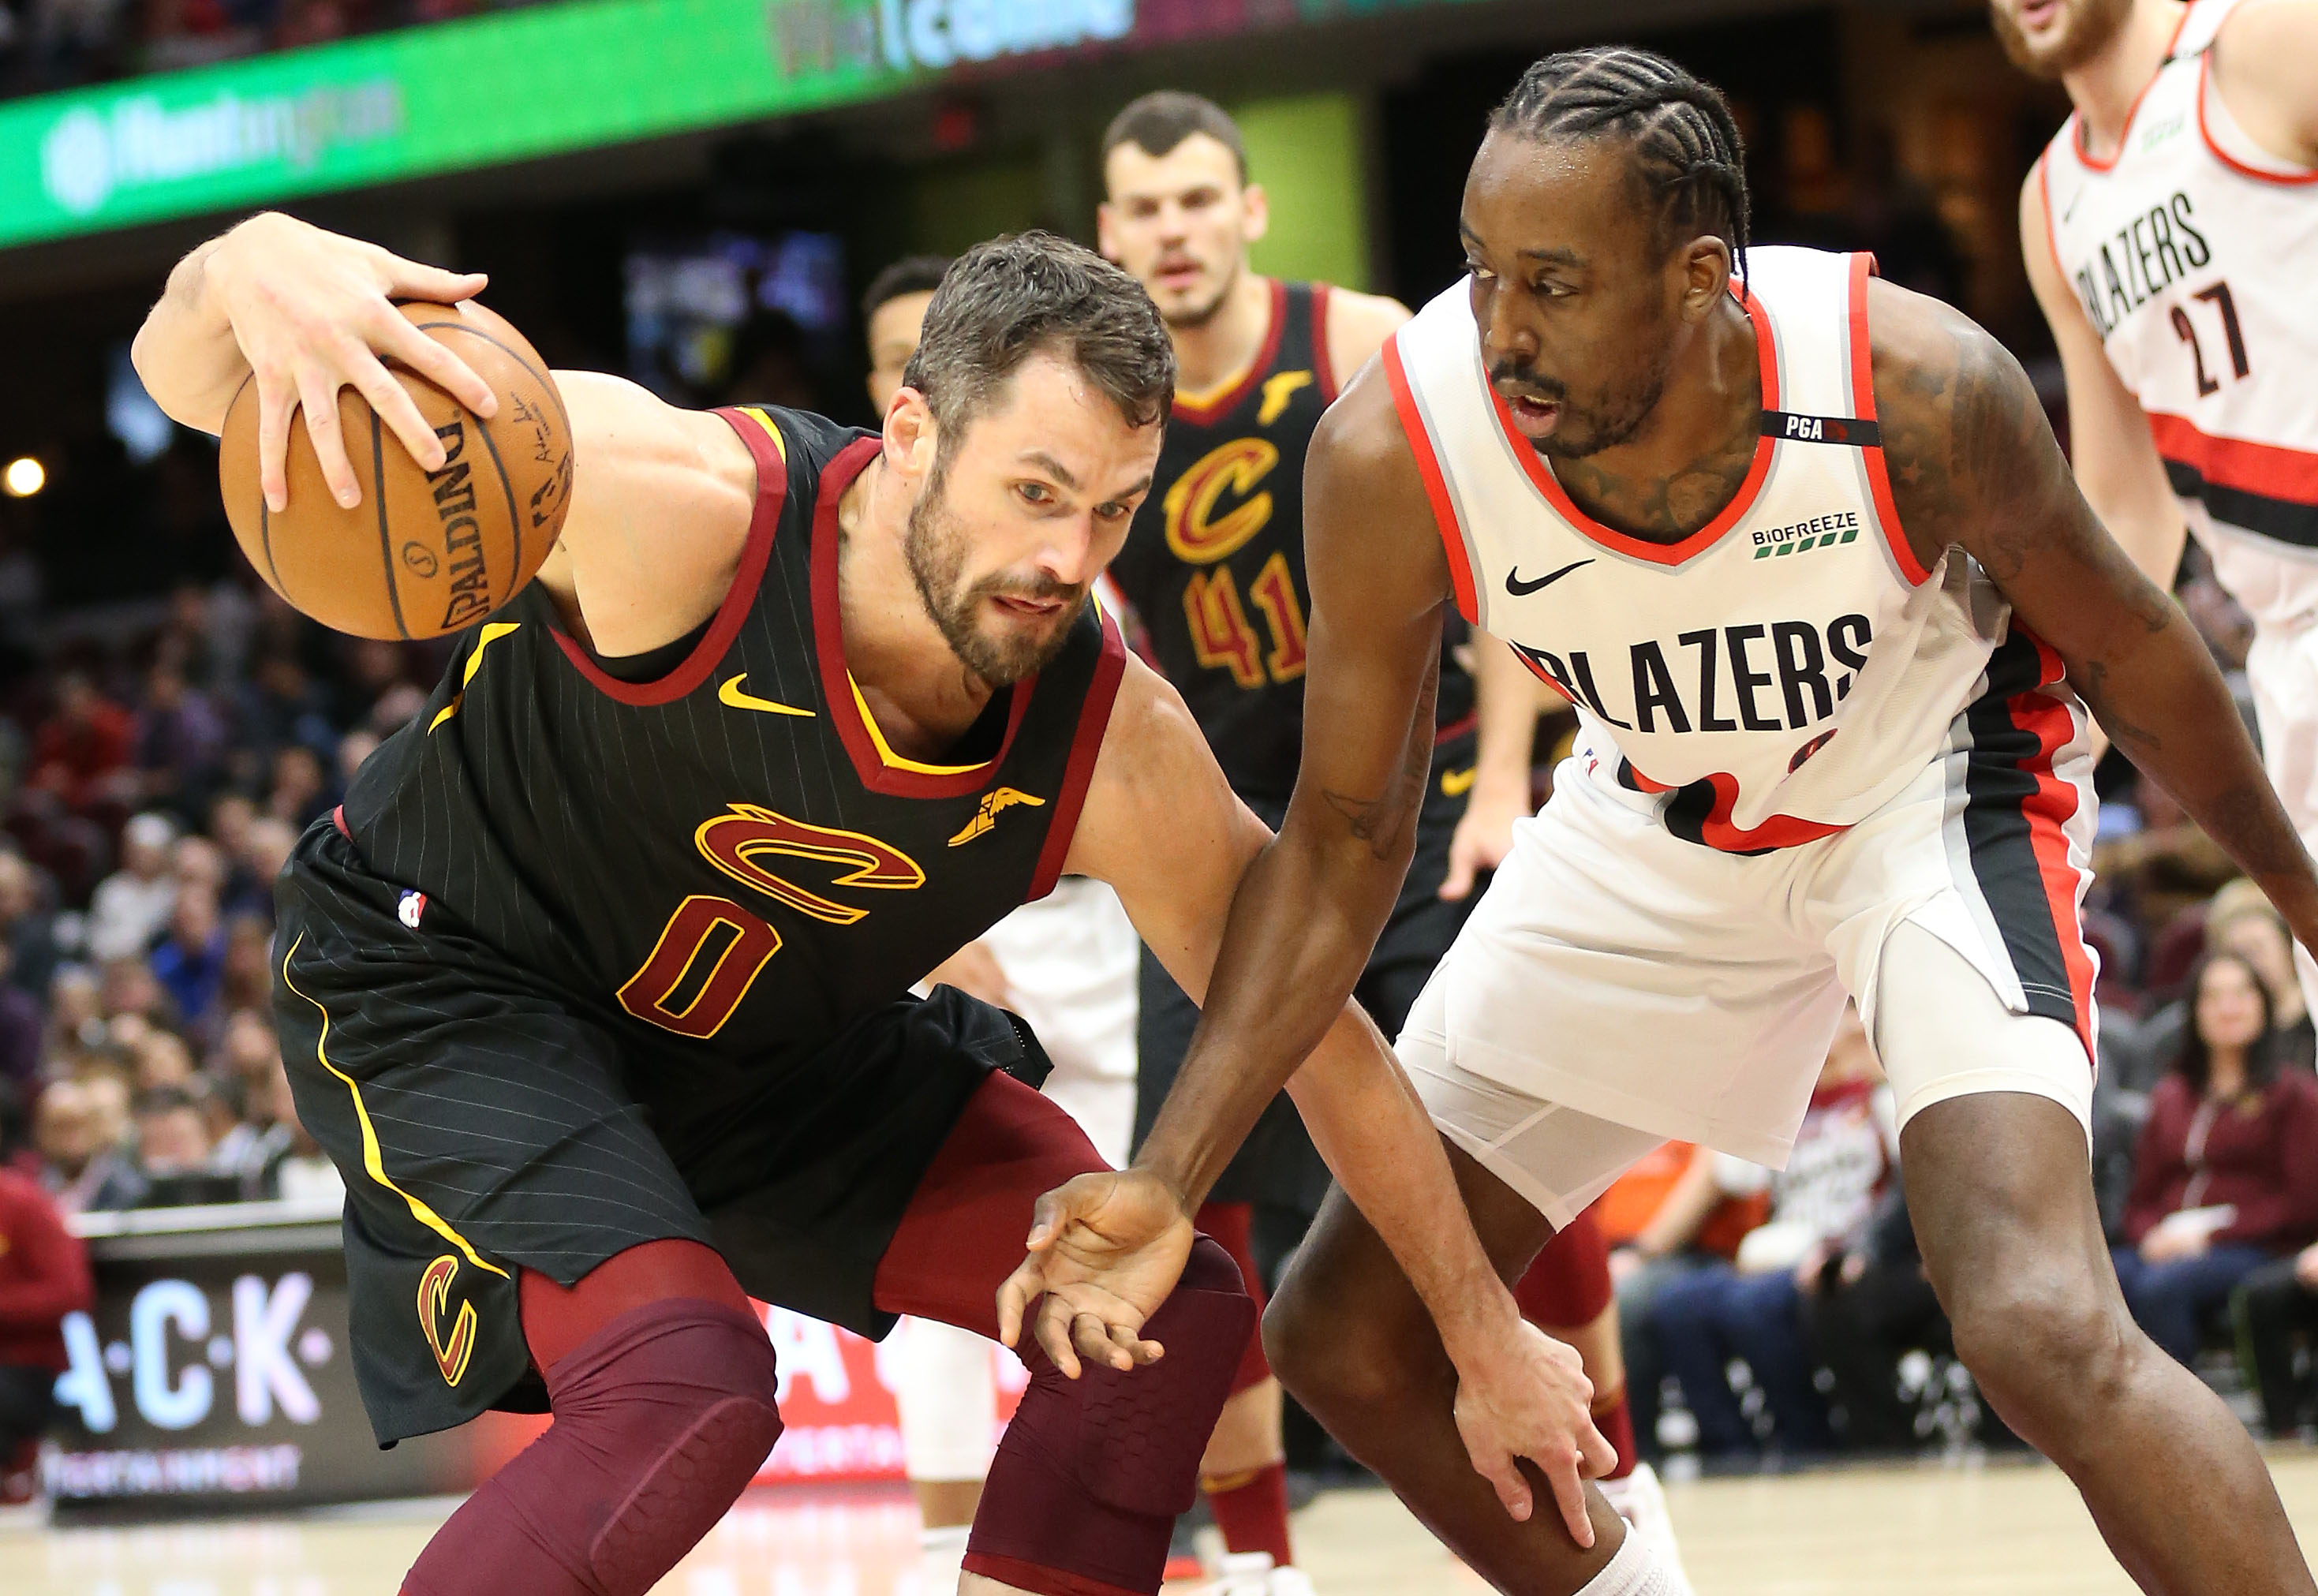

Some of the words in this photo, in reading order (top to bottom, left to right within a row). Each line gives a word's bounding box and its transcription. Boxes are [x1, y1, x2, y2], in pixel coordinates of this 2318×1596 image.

[2170, 281, 2249, 398] 27
[1785, 415, 1823, 440] PGA
[1183, 551, 1307, 689] 41
[616, 895, 782, 1039] 0
